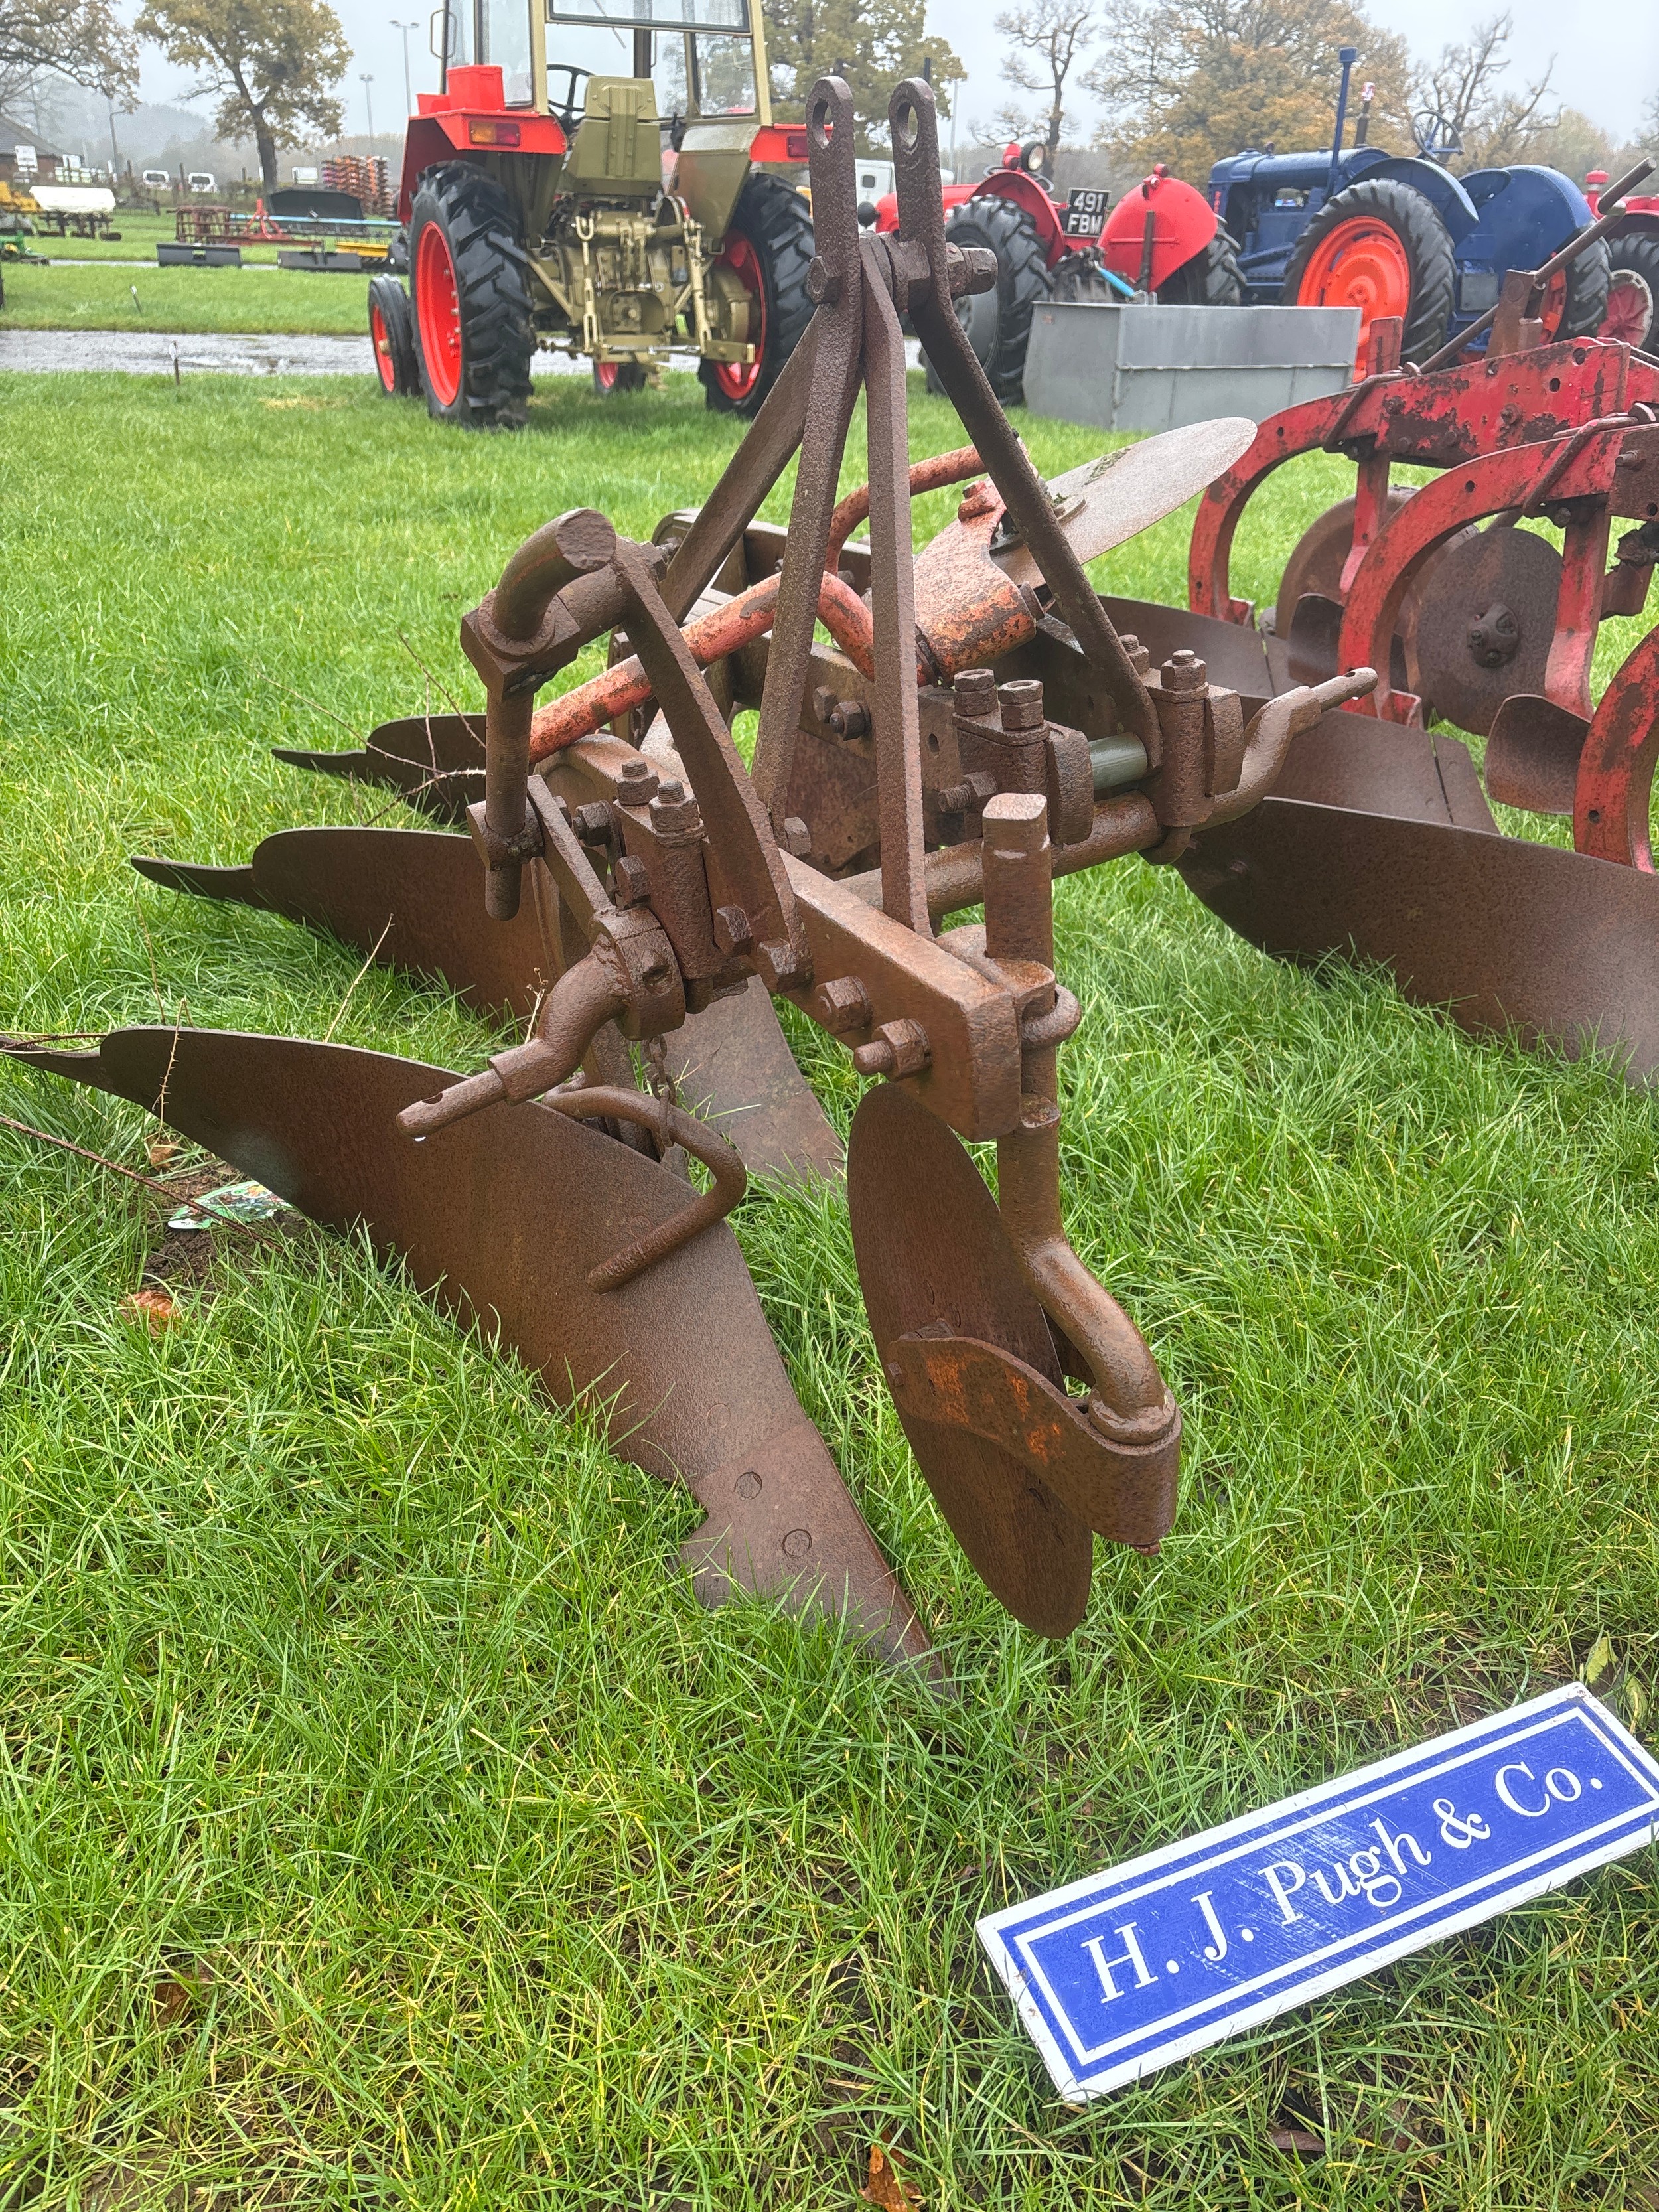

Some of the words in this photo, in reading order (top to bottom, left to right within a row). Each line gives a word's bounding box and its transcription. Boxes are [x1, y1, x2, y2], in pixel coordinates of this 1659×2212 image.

[1074, 192, 1104, 212] 491
[1067, 213, 1102, 234] FBM
[1081, 1921, 1180, 2004] H.
[1190, 1890, 1254, 1962] J.
[1258, 1816, 1431, 1926] Pugh
[1433, 1798, 1491, 1850] &
[1494, 1761, 1603, 1817] Co.
